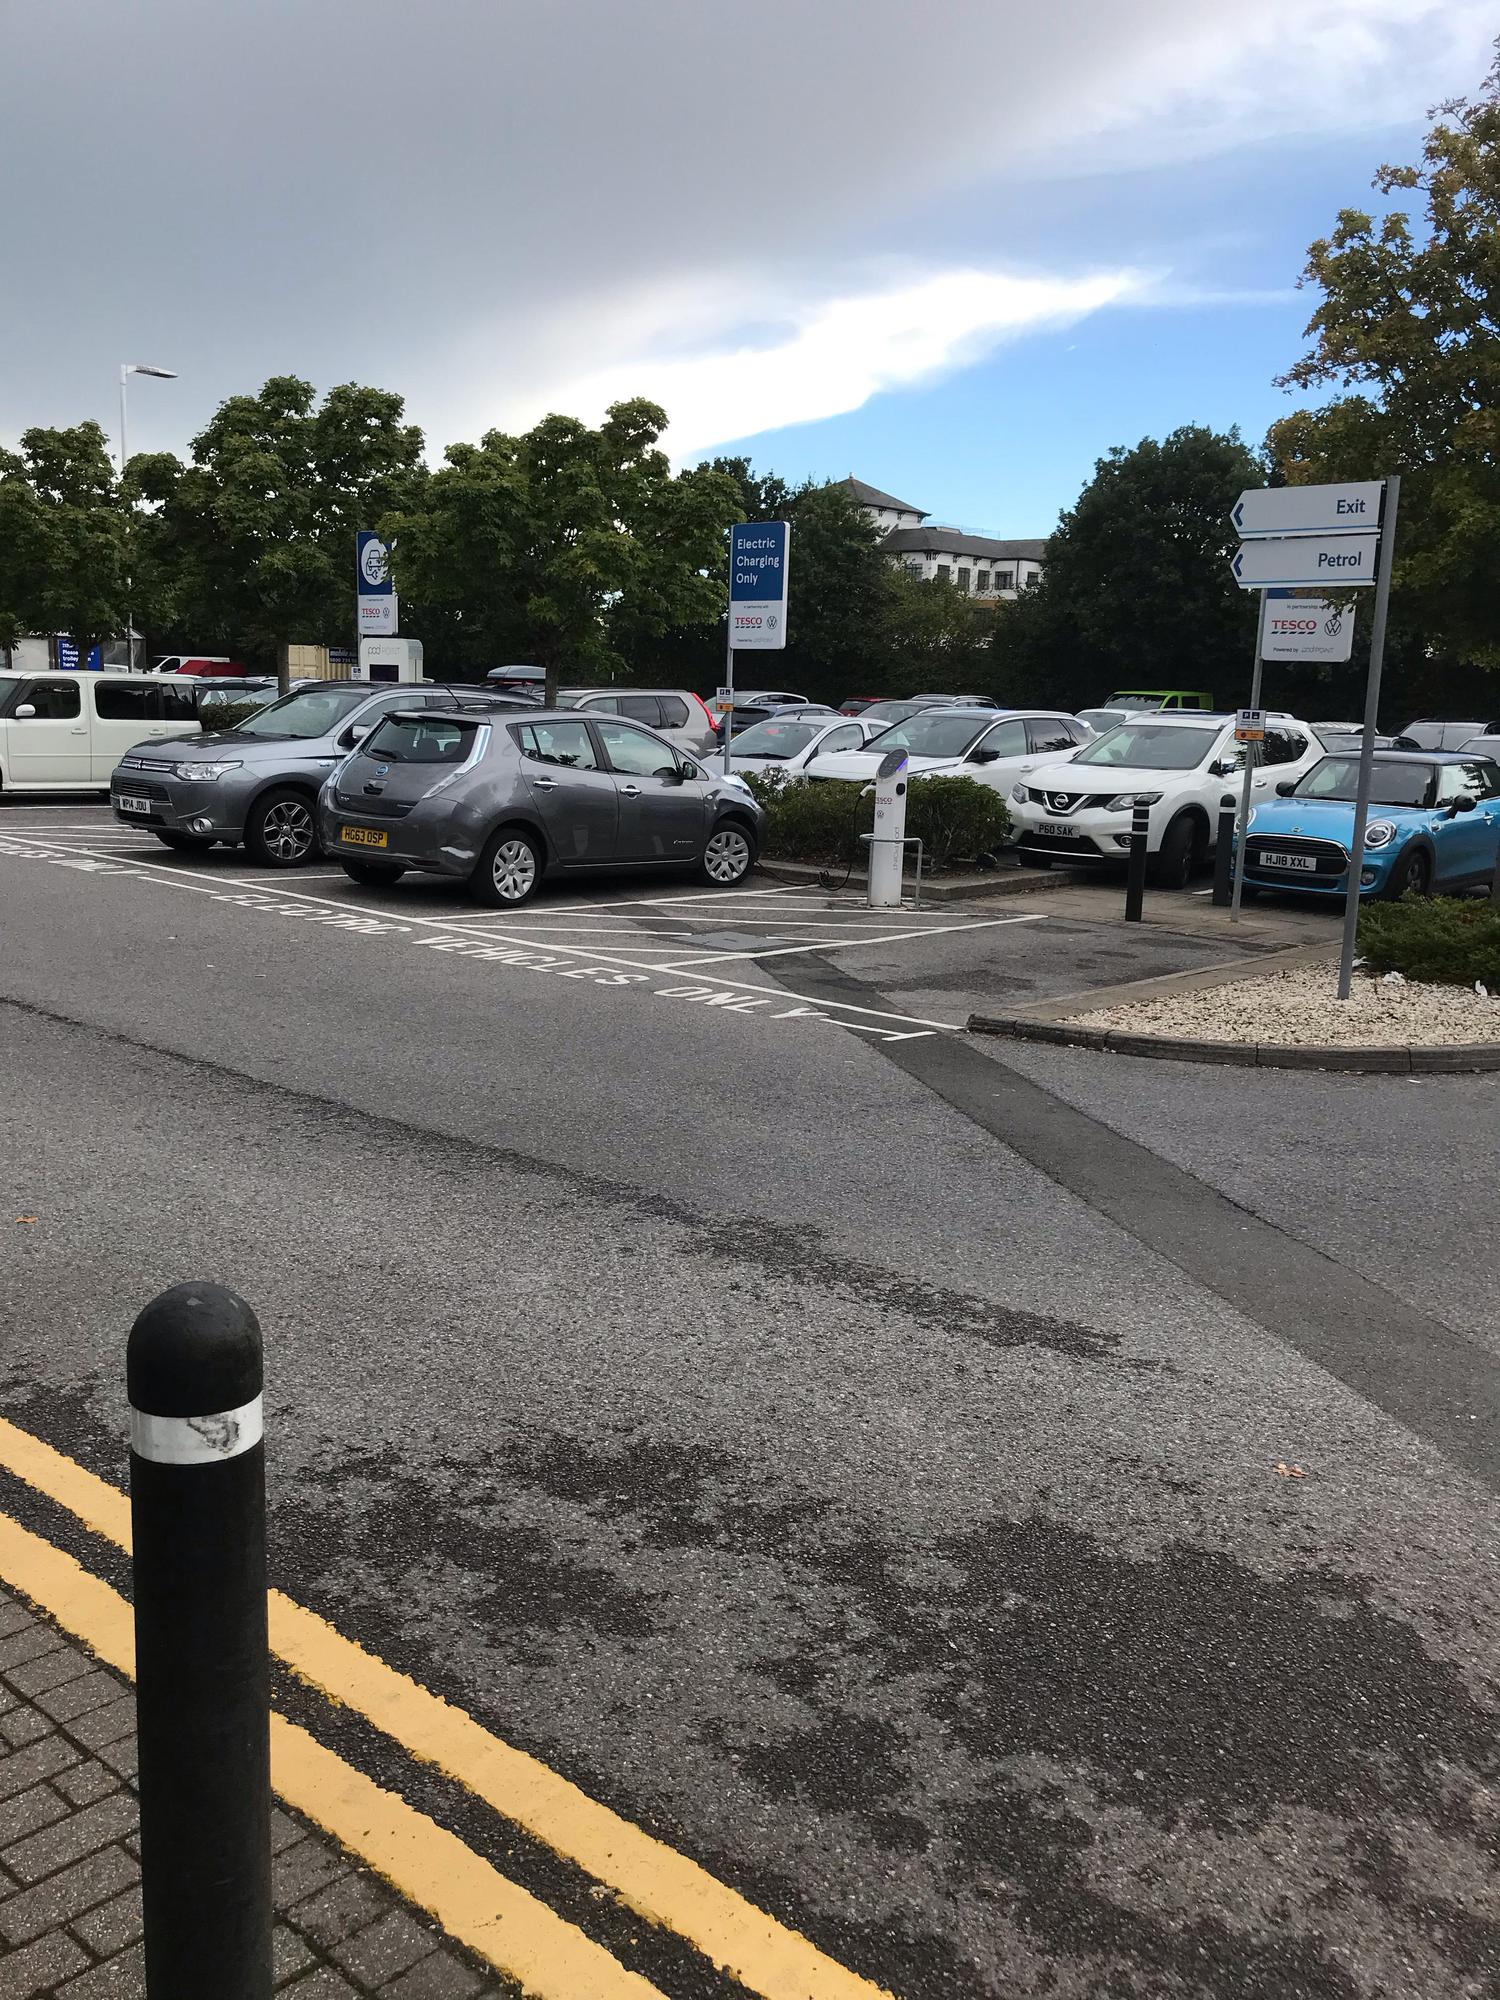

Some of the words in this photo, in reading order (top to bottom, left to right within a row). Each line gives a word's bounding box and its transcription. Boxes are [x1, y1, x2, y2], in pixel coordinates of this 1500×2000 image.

[1336, 499, 1366, 515] Exit
[737, 537, 776, 549] Electric
[736, 555, 780, 569] Charging
[1318, 551, 1362, 567] Petrol
[736, 572, 758, 586] Only
[735, 616, 763, 625] TESCO
[1271, 620, 1317, 630] TESCO
[344, 828, 366, 842] HG63
[1056, 826, 1074, 837] SAK
[47, 859, 150, 875] ONLY
[1265, 854, 1288, 866] HJ18
[1289, 857, 1310, 869] XXL
[210, 894, 414, 935] ELECTRIC
[411, 935, 651, 985] VEHICLES
[653, 986, 831, 1019] ONLY
